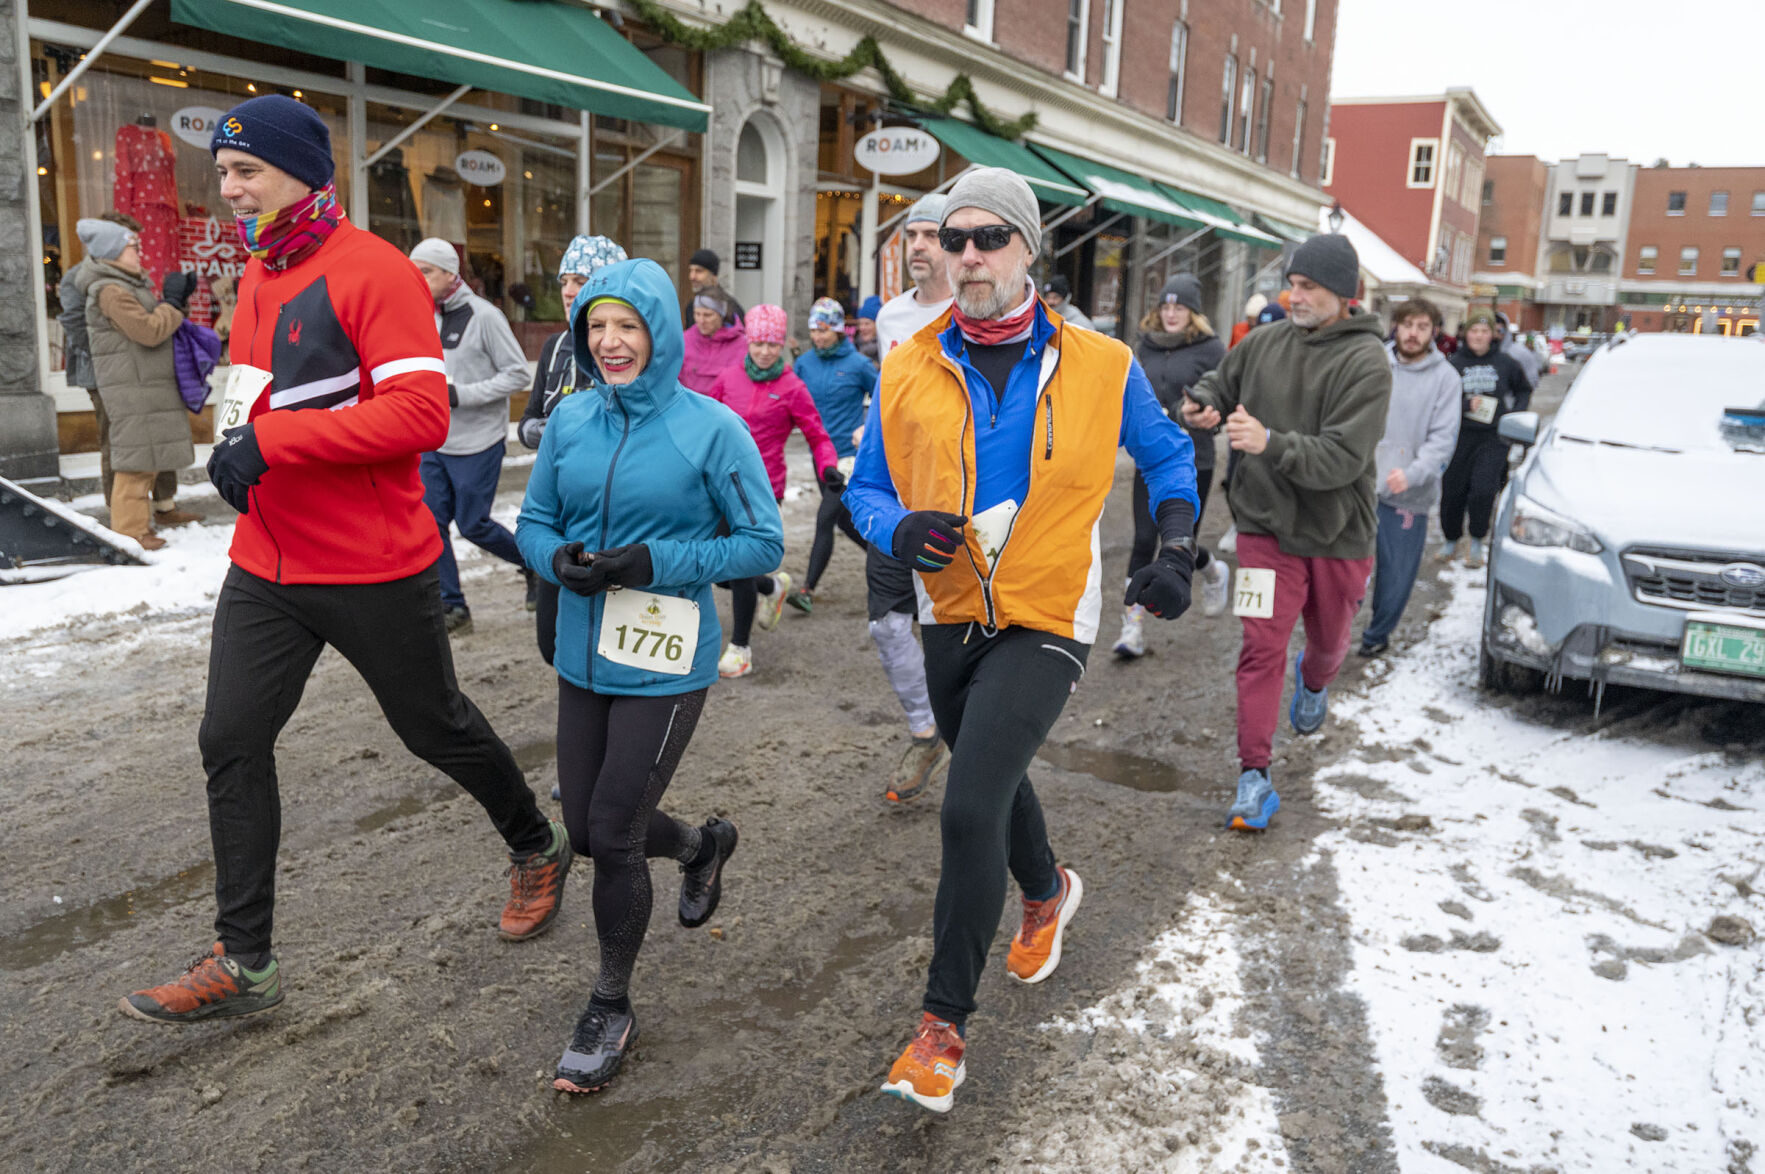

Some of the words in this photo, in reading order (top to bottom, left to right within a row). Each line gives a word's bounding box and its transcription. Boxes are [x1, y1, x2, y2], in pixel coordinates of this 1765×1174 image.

[180, 116, 215, 132] ROA
[866, 138, 918, 153] ROAM
[616, 624, 684, 661] 1776
